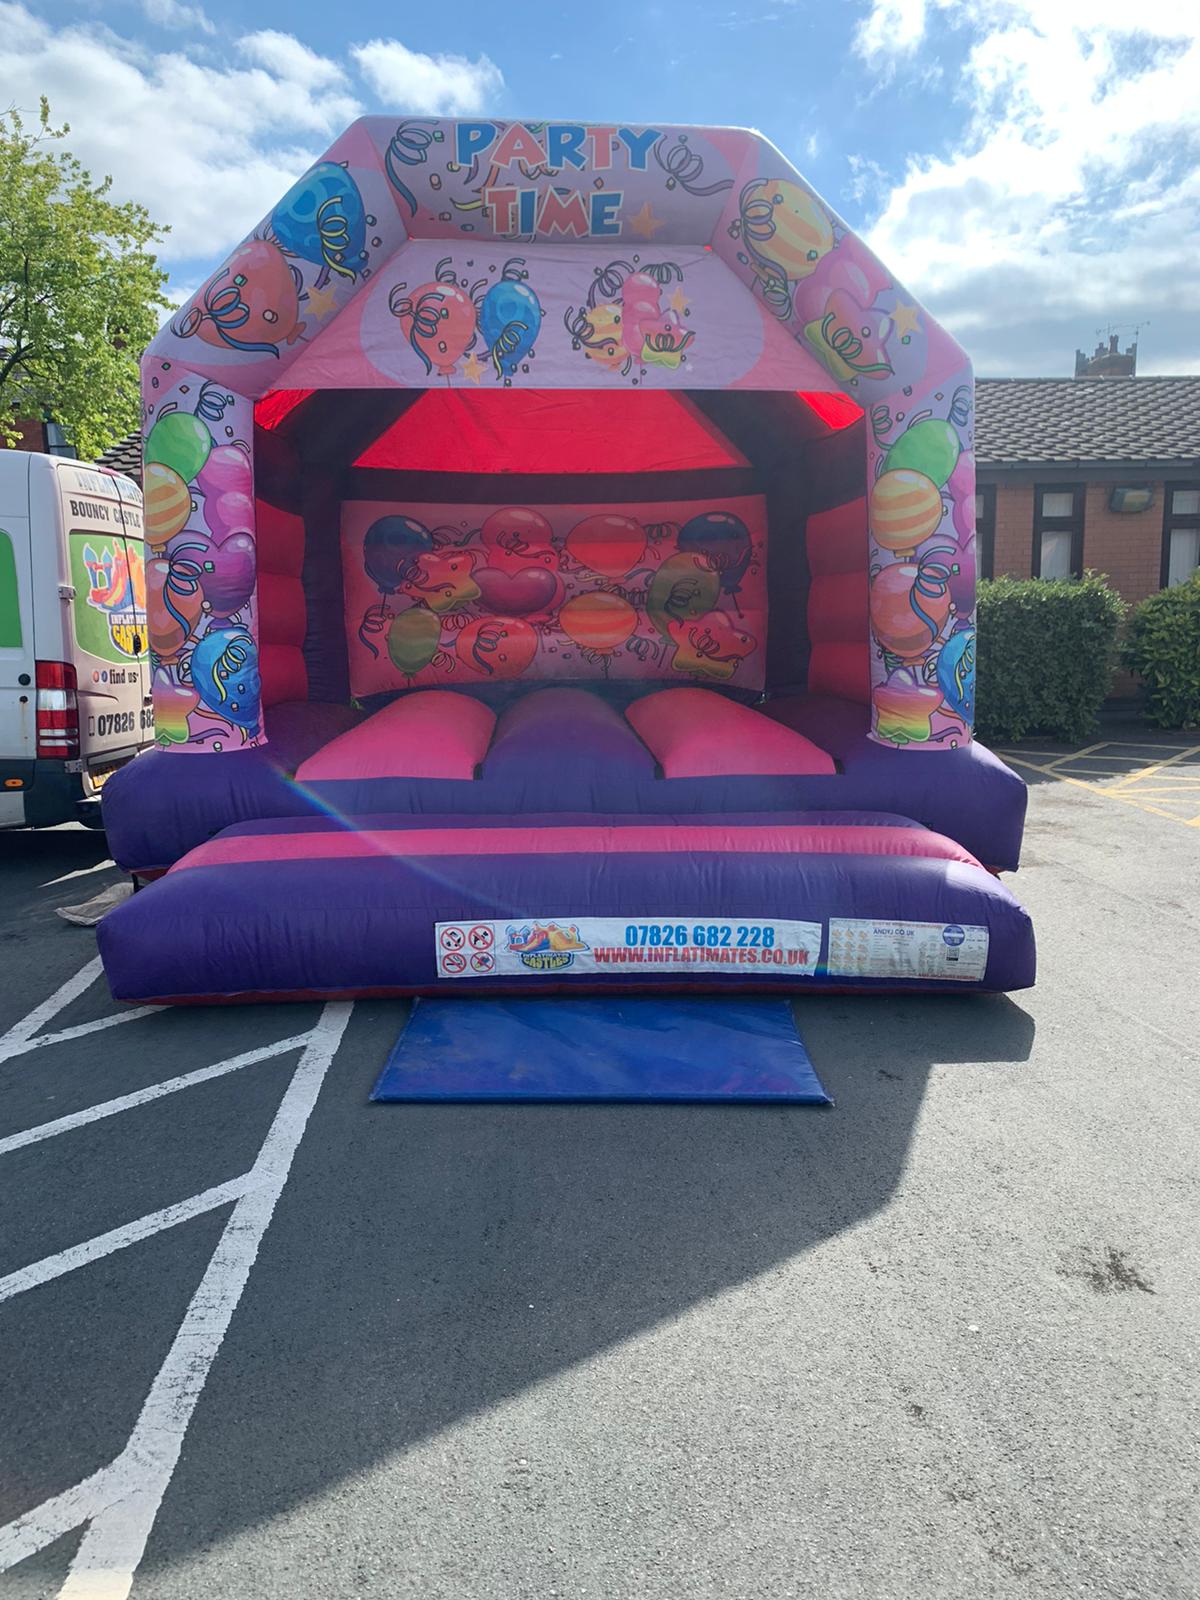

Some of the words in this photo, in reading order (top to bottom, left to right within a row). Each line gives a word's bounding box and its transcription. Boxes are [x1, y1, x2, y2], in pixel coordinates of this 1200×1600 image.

[456, 121, 664, 171] PARTY
[484, 185, 624, 238] TIME
[70, 500, 110, 521] BOUNCY
[109, 669, 126, 684] find
[98, 711, 135, 737] 07826
[625, 925, 688, 947] 07826
[693, 925, 731, 947] 682
[736, 926, 775, 948] 228
[594, 947, 809, 966] WWW.INFLATIMATES.CO.UK
